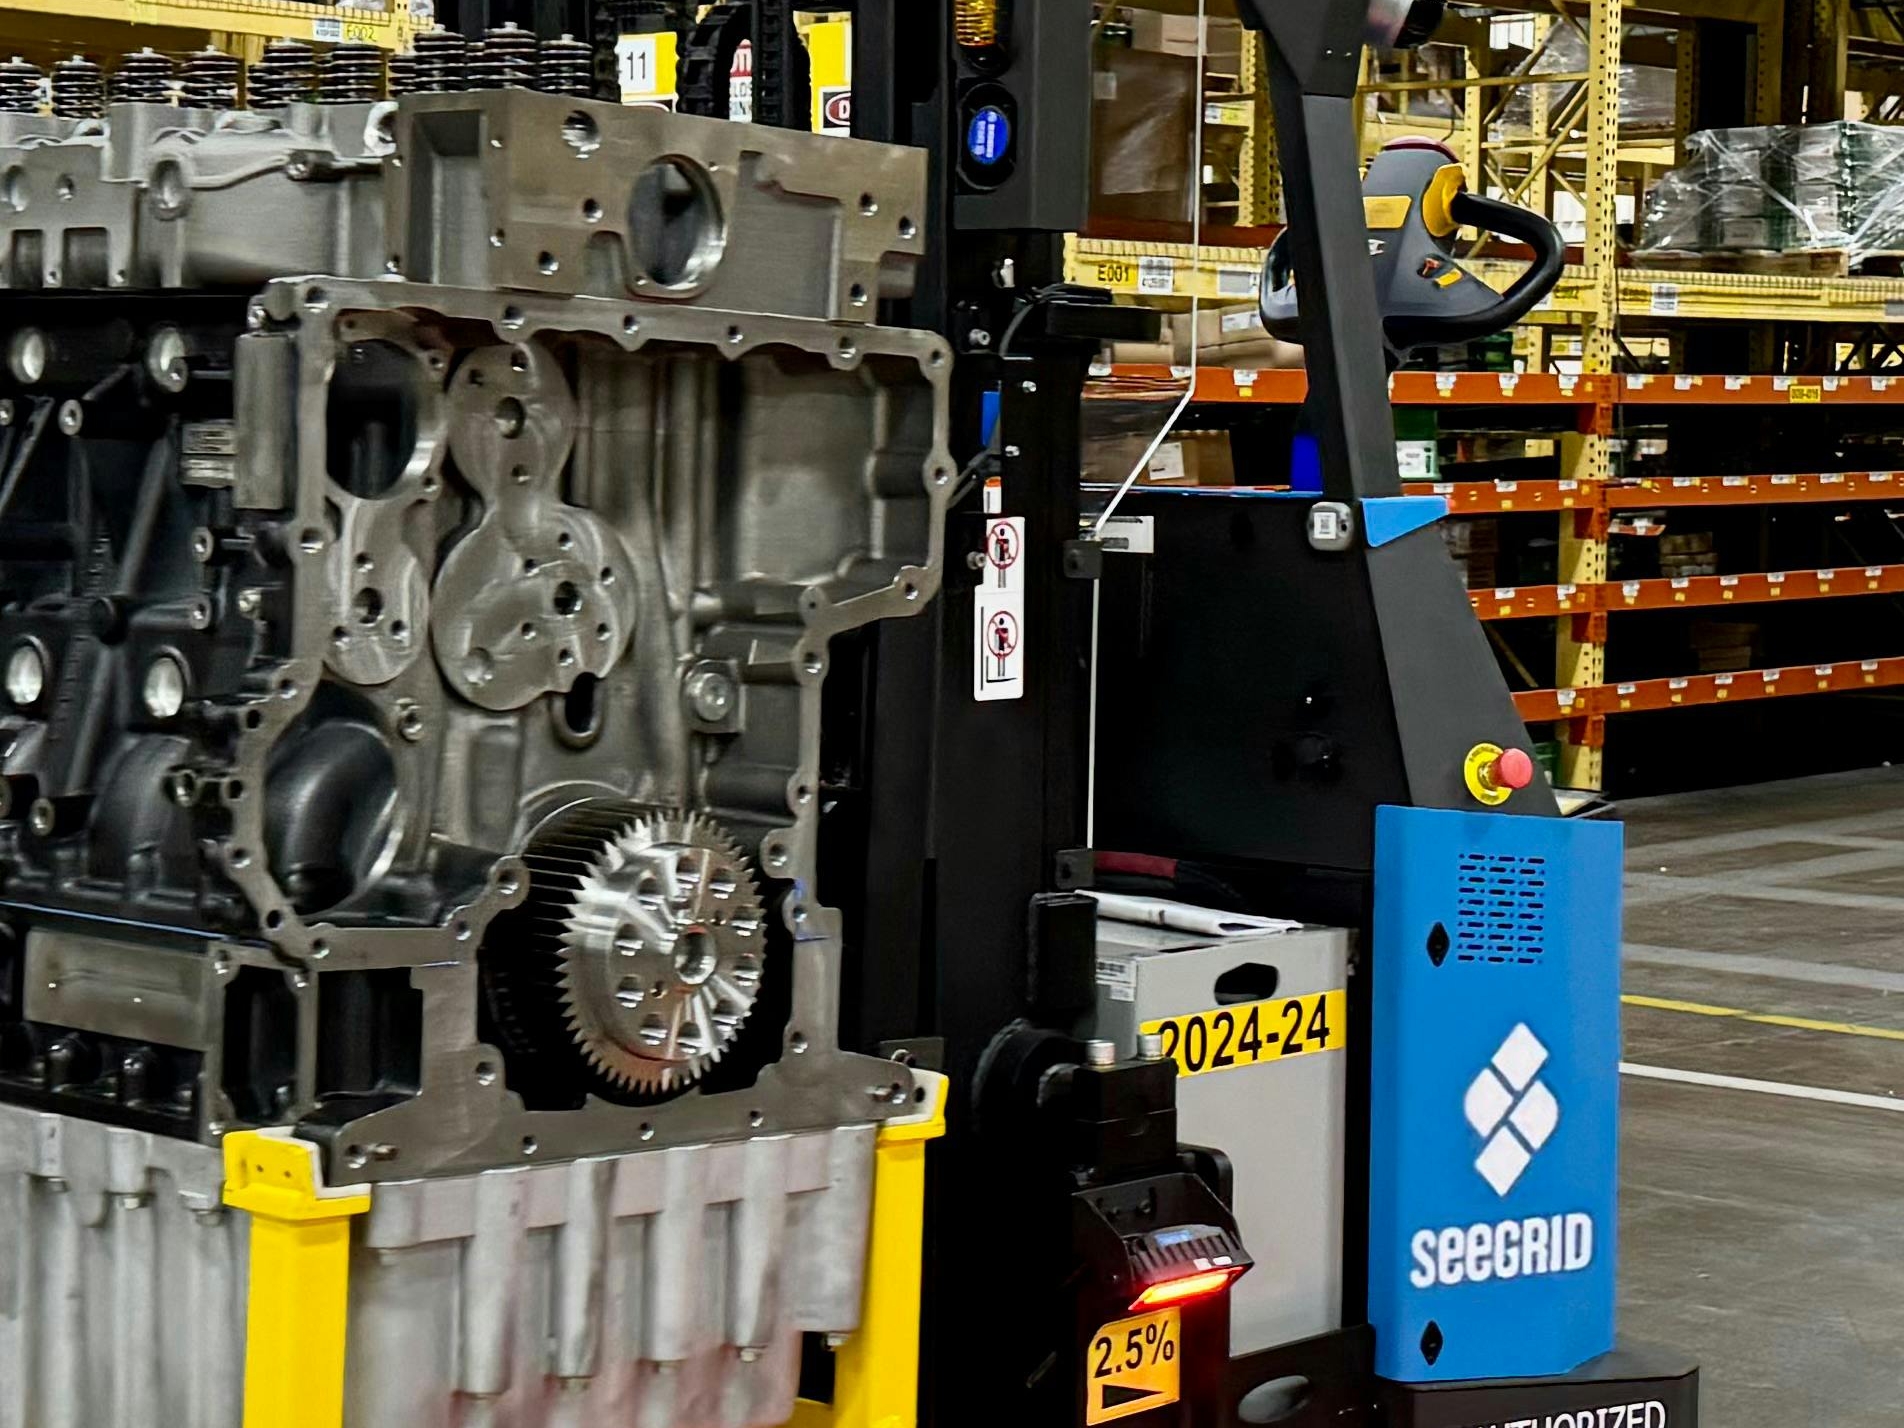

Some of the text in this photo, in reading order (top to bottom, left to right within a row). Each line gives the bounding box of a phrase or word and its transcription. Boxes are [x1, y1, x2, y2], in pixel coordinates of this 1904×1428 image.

[626, 51, 646, 81] 11
[1097, 263, 1130, 283] E001
[1160, 994, 1330, 1072] 2024-24
[1093, 1320, 1175, 1379] 2.5%
